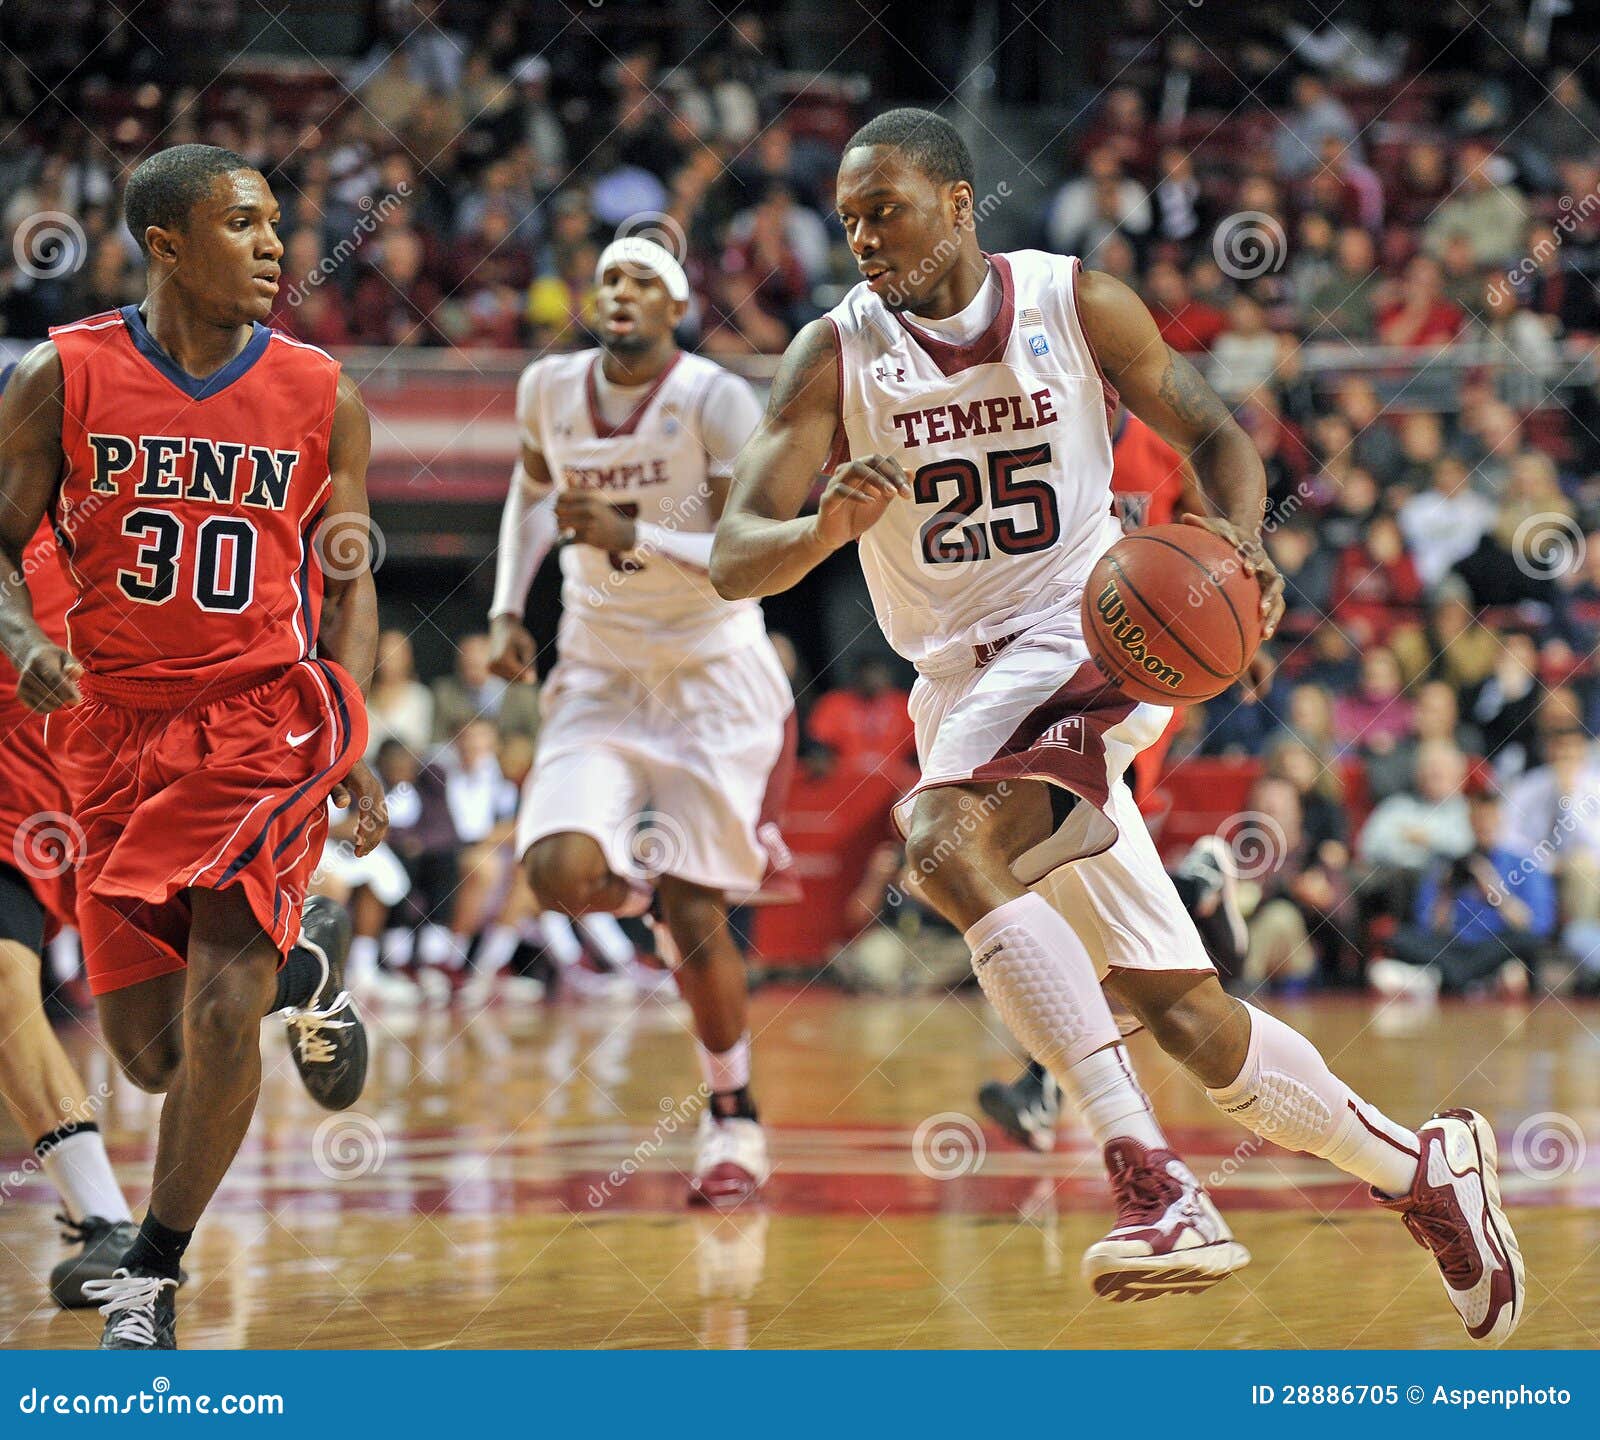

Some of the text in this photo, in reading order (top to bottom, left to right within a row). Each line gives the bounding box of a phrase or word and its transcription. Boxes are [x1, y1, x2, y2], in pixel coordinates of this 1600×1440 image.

[87, 432, 301, 511] PENN
[892, 388, 1059, 449] TEMPLE
[913, 442, 1062, 565] 25
[116, 506, 259, 614] 30
[1097, 579, 1185, 689] Wilson
